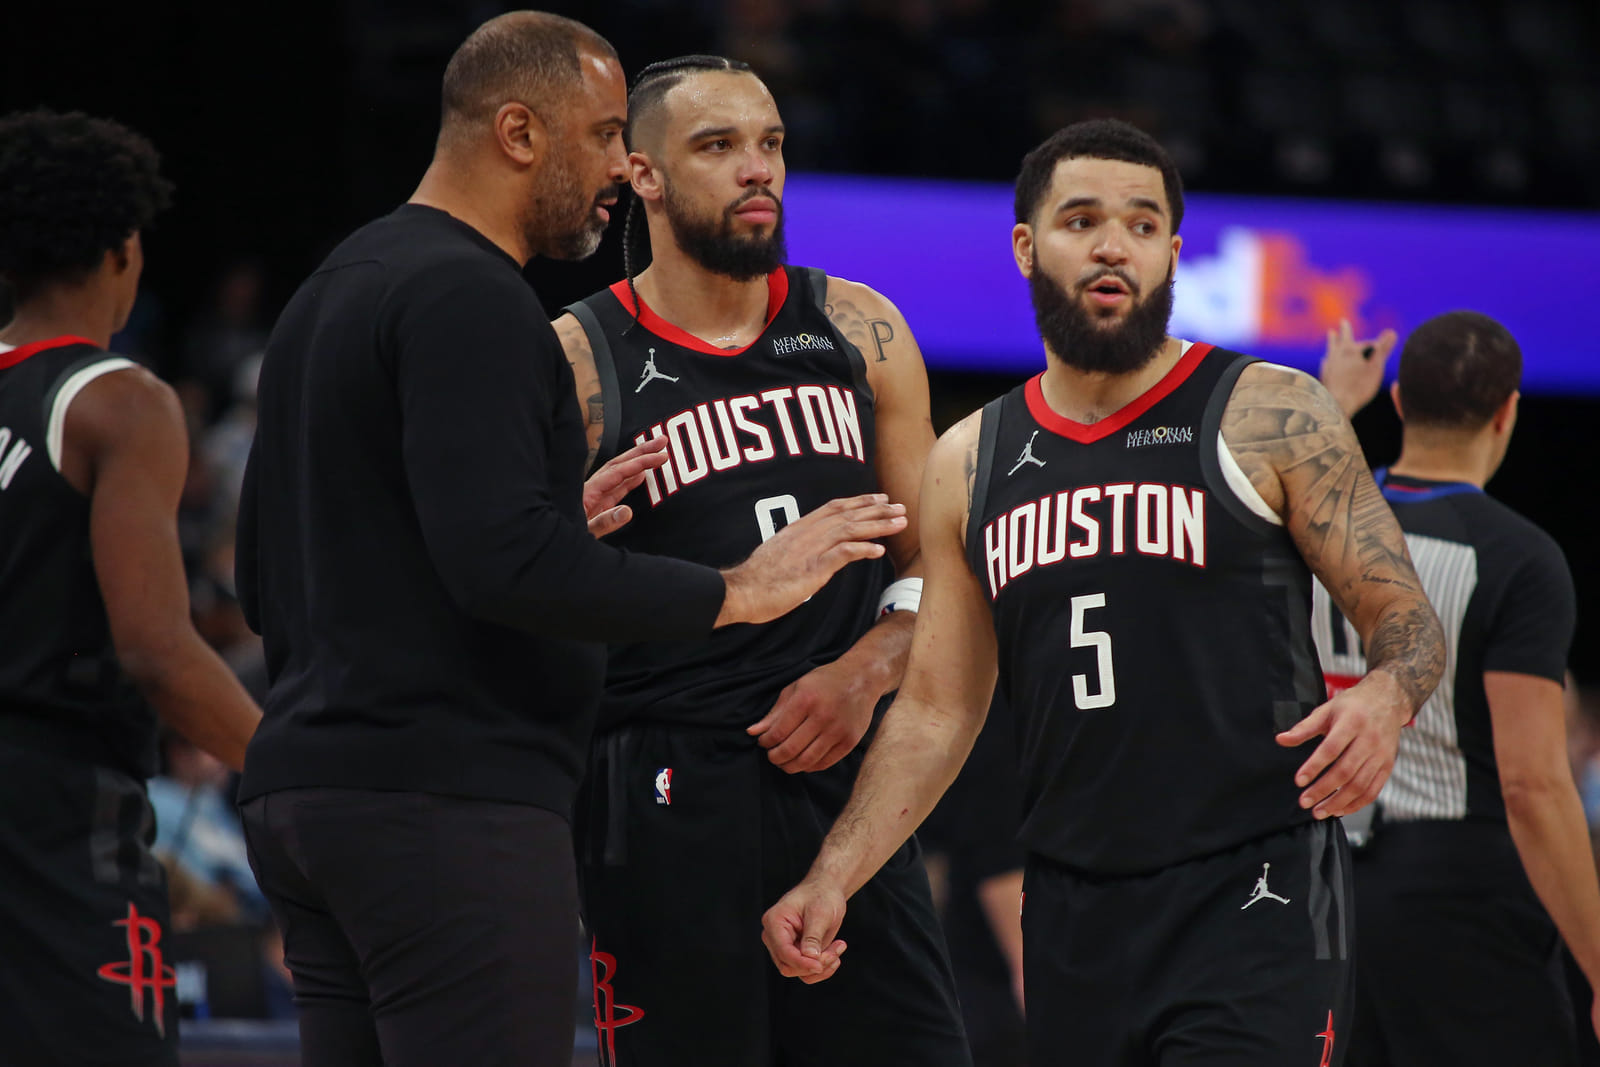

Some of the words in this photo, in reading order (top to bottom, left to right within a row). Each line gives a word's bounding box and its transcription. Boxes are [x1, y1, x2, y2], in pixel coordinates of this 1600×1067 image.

[773, 333, 832, 347] MEMORIAL
[774, 340, 834, 355] HERMANN
[1127, 433, 1192, 448] HERMANN
[1128, 426, 1193, 440] MEMORIAL
[633, 384, 865, 507] HOUSTON
[984, 481, 1207, 601] HOUSTON
[1070, 592, 1116, 710] 5
